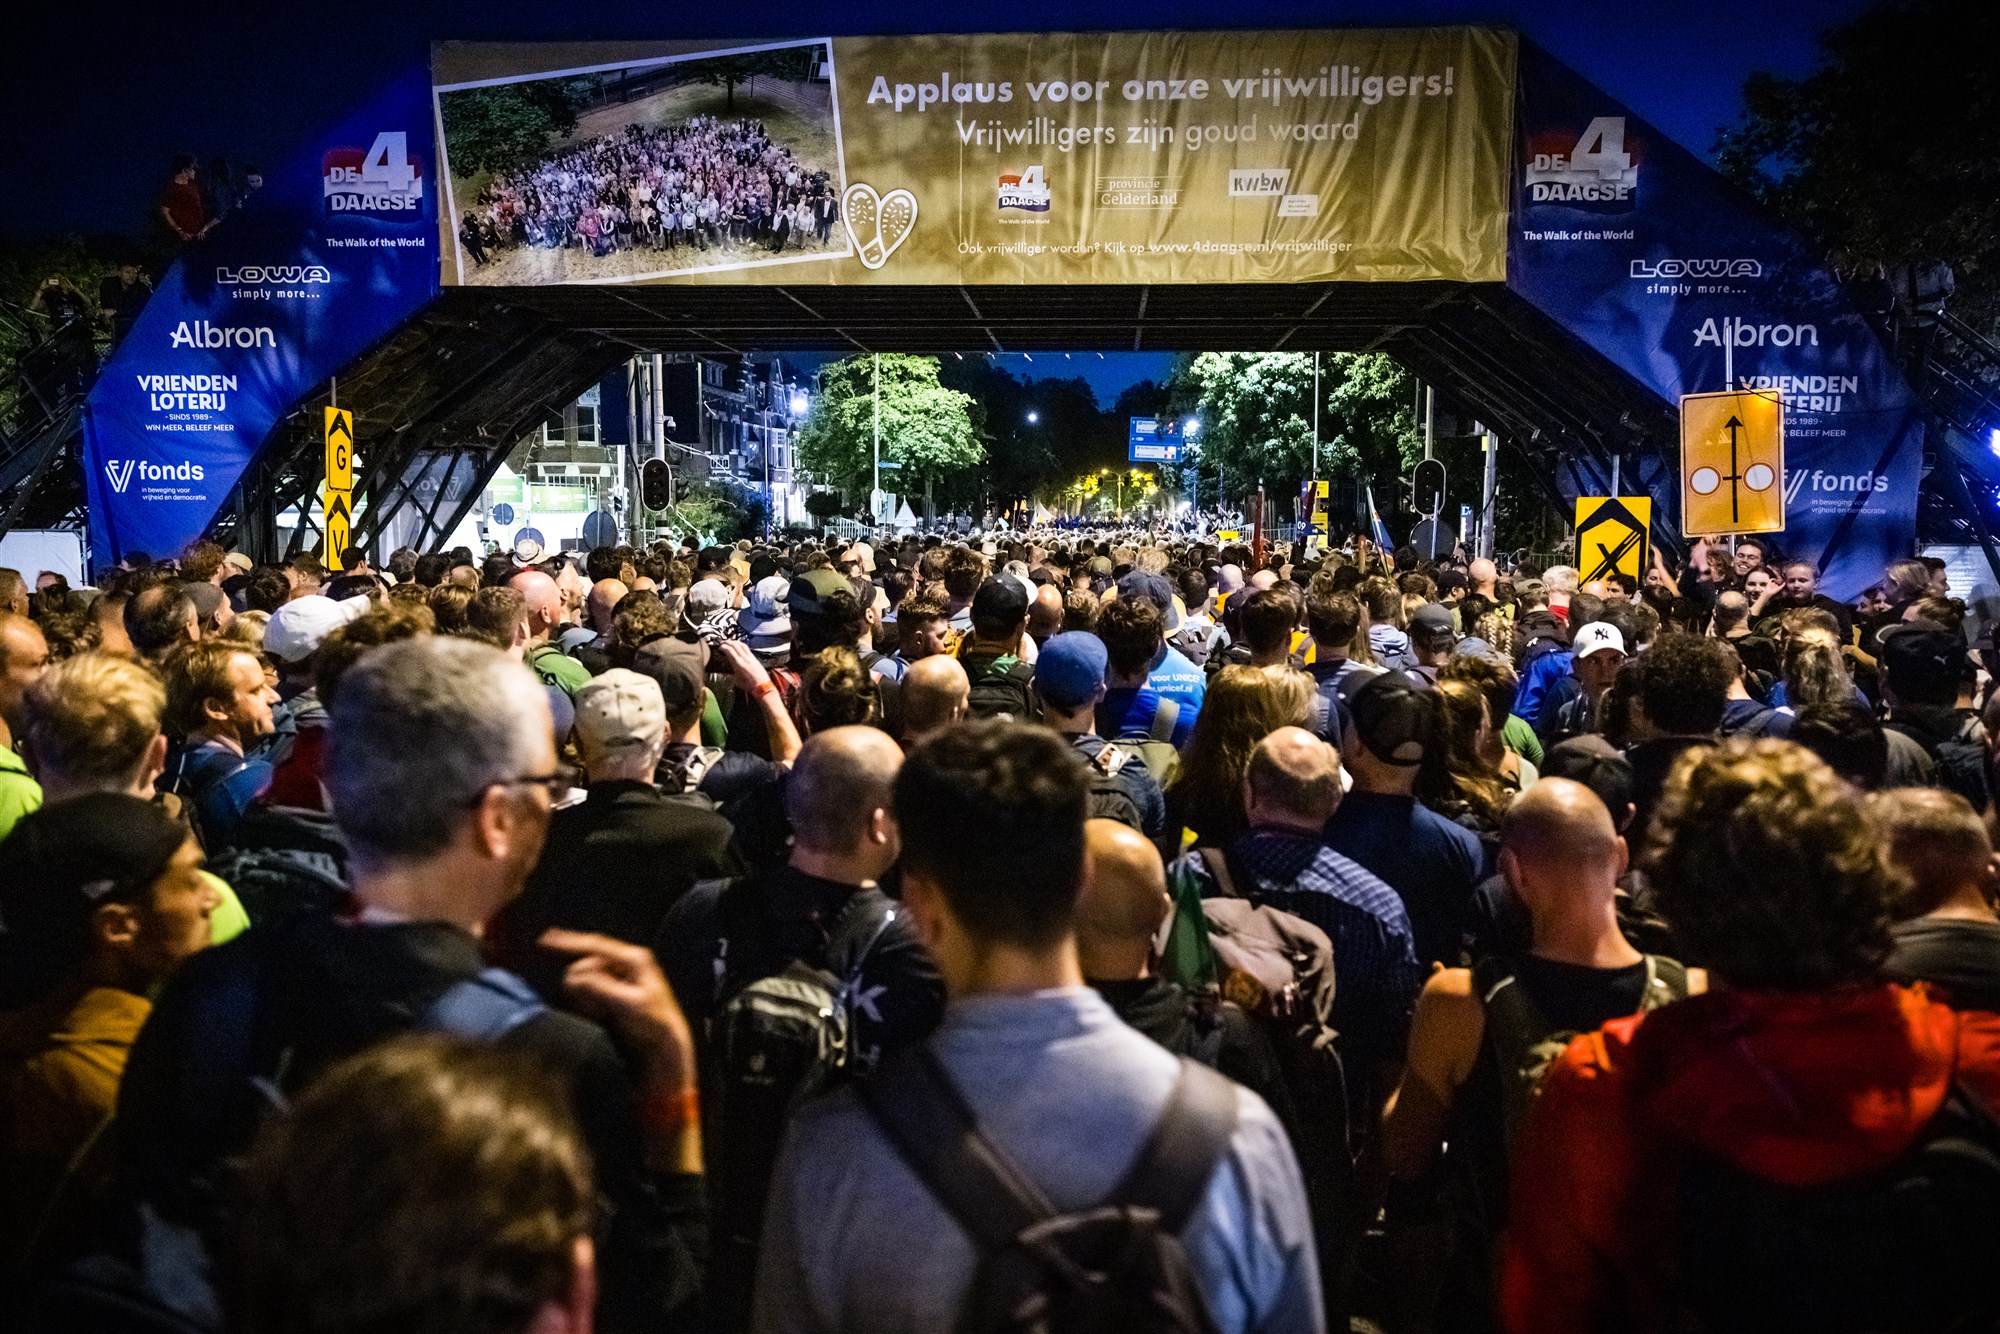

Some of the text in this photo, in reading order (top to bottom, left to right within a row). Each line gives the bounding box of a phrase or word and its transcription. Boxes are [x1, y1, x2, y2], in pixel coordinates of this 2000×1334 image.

[867, 65, 1454, 112] Applaus voor onze vrijwilligers!
[956, 112, 1359, 153] Vrijwilligers zijn goud waard
[1534, 116, 1631, 180] DE 4
[330, 131, 415, 190] DE 4
[1002, 165, 1046, 195] DE 4
[1109, 178, 1160, 191] provincie
[1101, 192, 1177, 205] Gelderland
[1533, 183, 1629, 201] DAAGSE
[331, 194, 416, 211] DAAGSE
[1002, 197, 1047, 206] DAAGSE
[326, 238, 425, 247] The Walk of the World
[1523, 230, 1634, 240] The Walk of the World
[958, 240, 1352, 256] Ook vrijwilliger worden? Kijk op www.4daagse.nl/vrijwilliger
[217, 266, 330, 283] LOWA
[1630, 259, 1762, 278] LOWA
[232, 289, 320, 300] simply more...
[1646, 283, 1747, 296] simply more...
[170, 320, 276, 348] Albron
[1693, 316, 1818, 347] Albron
[137, 375, 238, 392] VRIENDEN
[151, 393, 226, 411] LOTERIJ
[1784, 395, 1841, 415] TERIJ
[162, 424, 185, 432] MEER,
[336, 444, 347, 471] G
[138, 461, 204, 480] fonds
[1812, 470, 1889, 492] fonds
[1819, 499, 1853, 507] beweging
[333, 530, 344, 558] V
